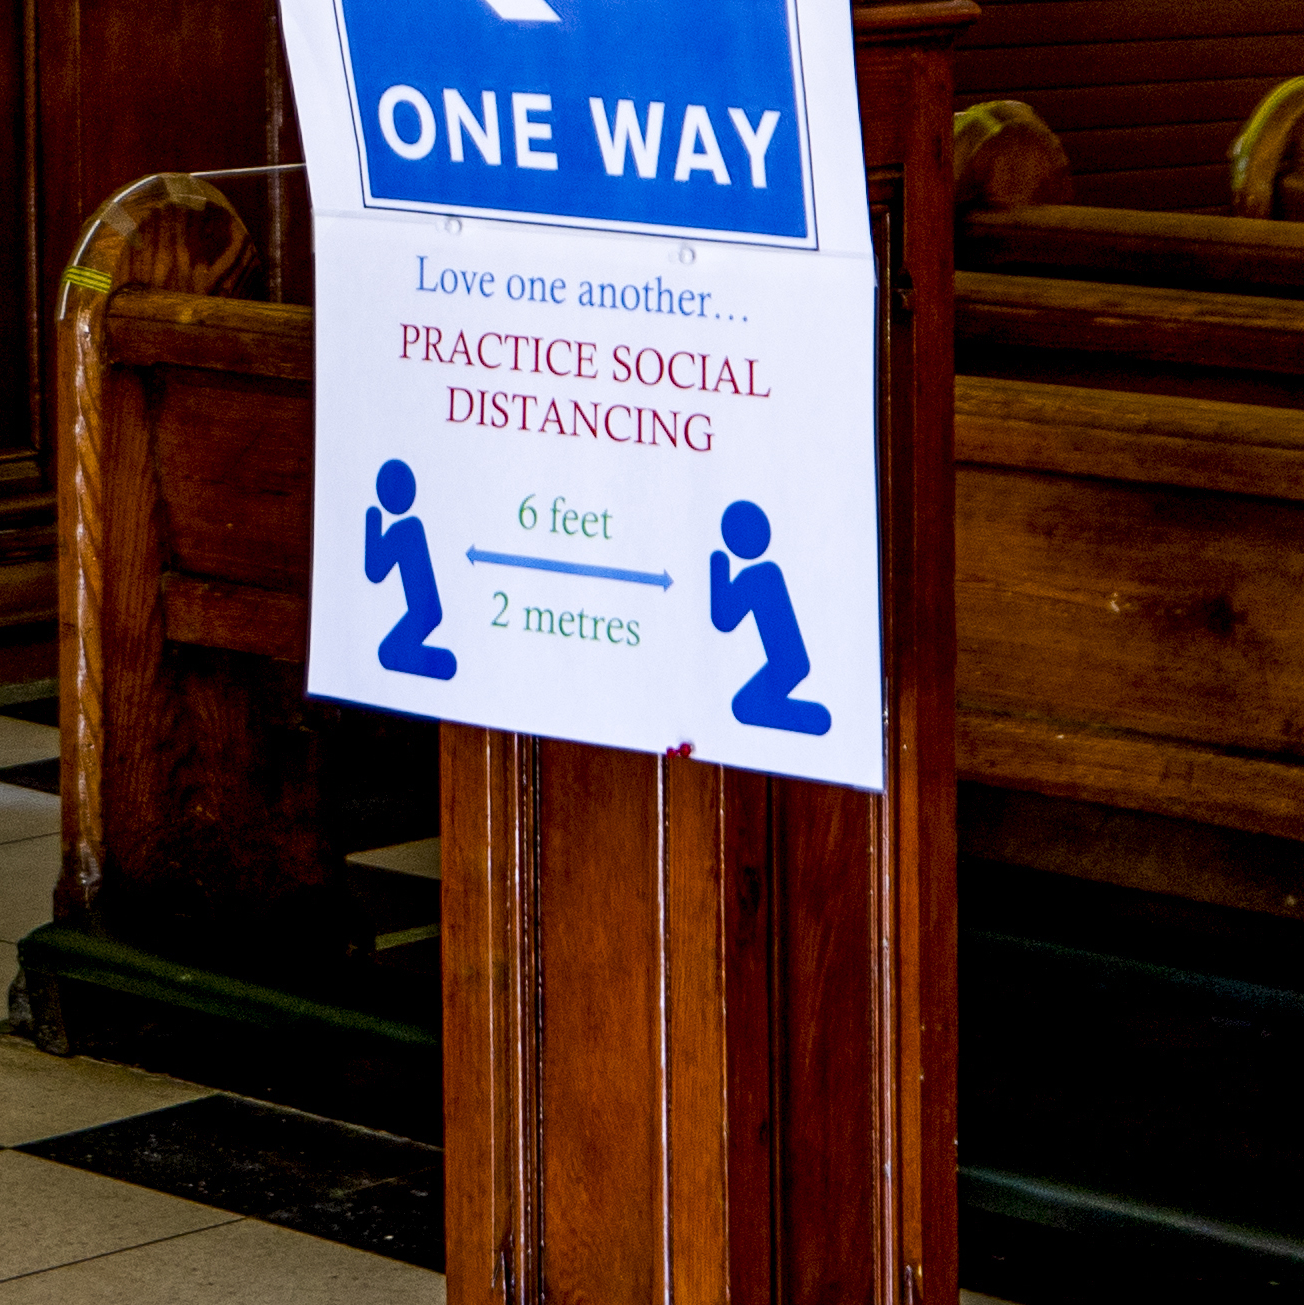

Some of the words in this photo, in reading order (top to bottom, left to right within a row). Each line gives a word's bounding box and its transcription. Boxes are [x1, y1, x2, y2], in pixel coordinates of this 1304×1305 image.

[379, 85, 558, 170] ONE
[589, 98, 780, 188] WAY
[416, 255, 495, 298] Love
[506, 275, 566, 305] one
[400, 323, 597, 379] PRACTICE
[612, 345, 770, 398] SOCIAL
[446, 386, 716, 452] DISTANCING
[518, 494, 538, 530] 6
[550, 496, 612, 540] feet
[491, 590, 509, 628] 2
[524, 607, 640, 646] metres
